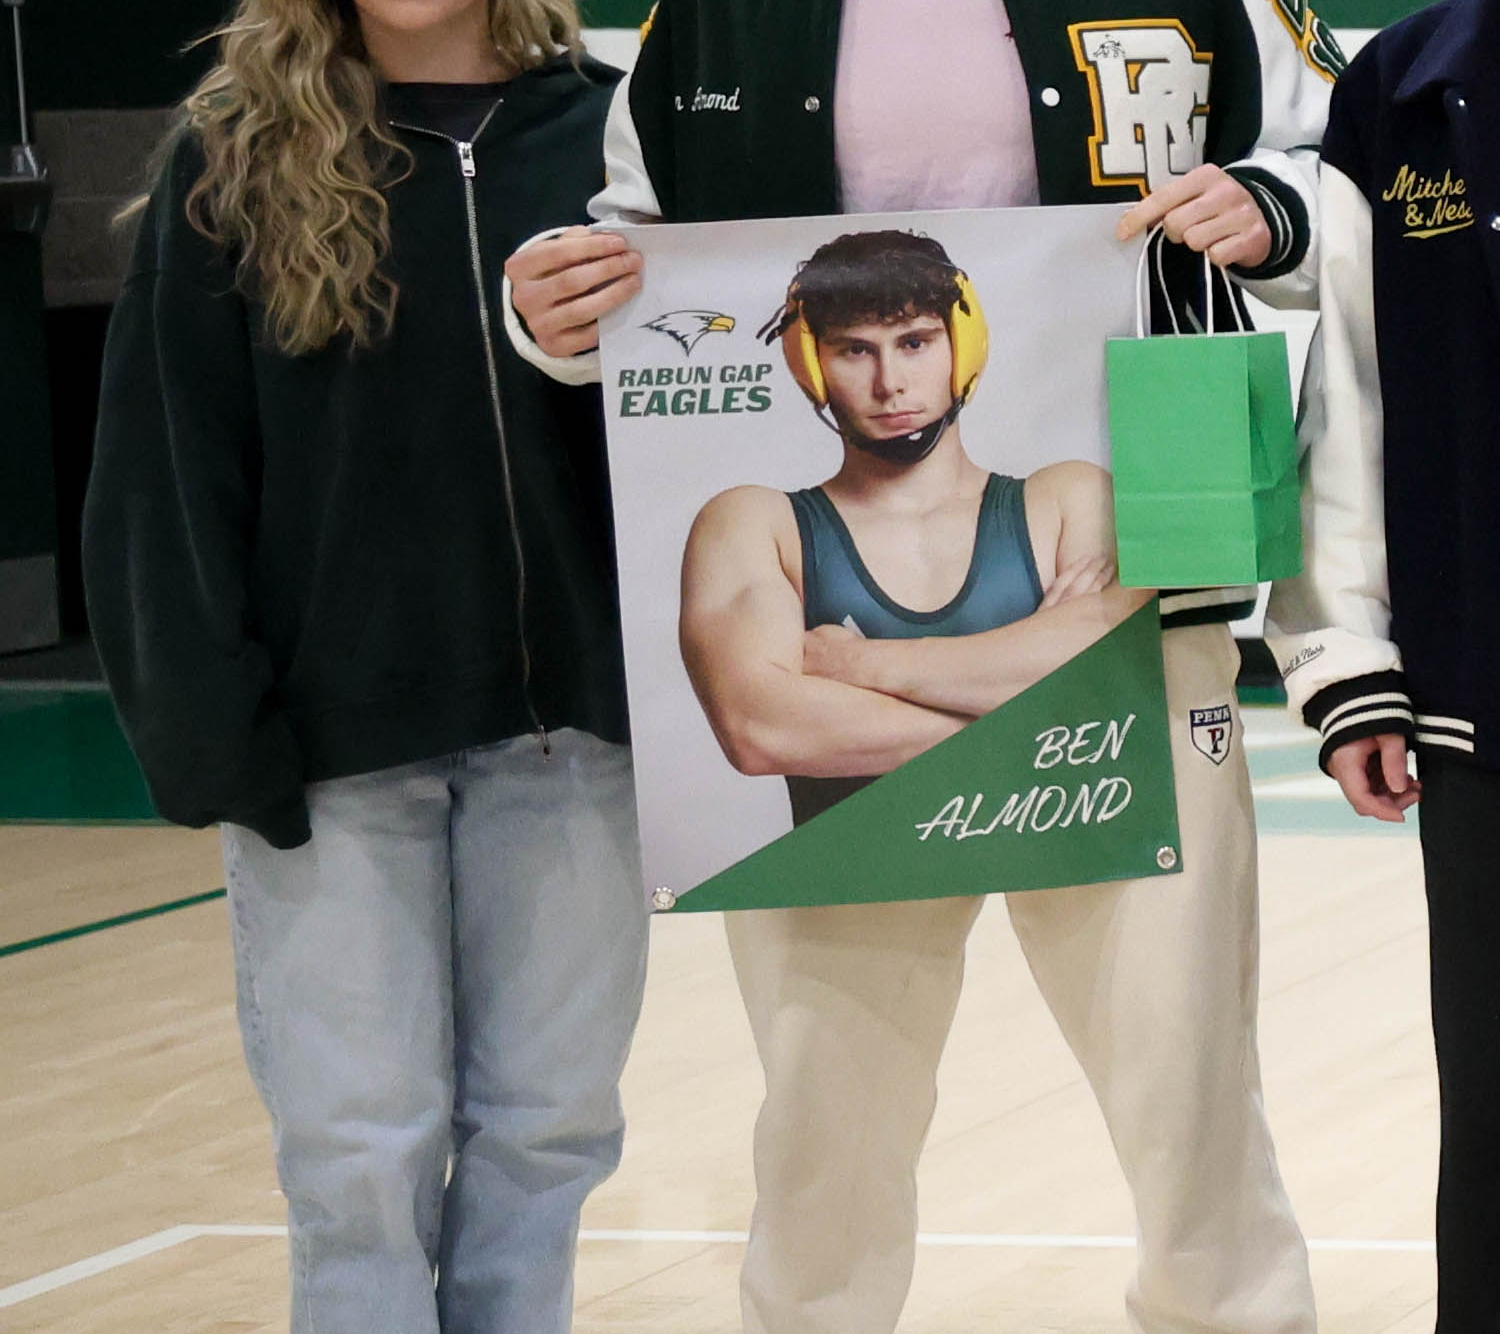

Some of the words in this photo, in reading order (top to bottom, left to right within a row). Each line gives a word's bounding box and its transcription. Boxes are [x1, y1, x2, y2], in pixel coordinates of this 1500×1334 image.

[1404, 203, 1425, 227] &
[617, 365, 715, 389] RABUN
[719, 363, 774, 385] GAP
[618, 386, 774, 418] EAGLES
[1033, 713, 1137, 771] BEN
[914, 776, 1134, 842] ALMOND
